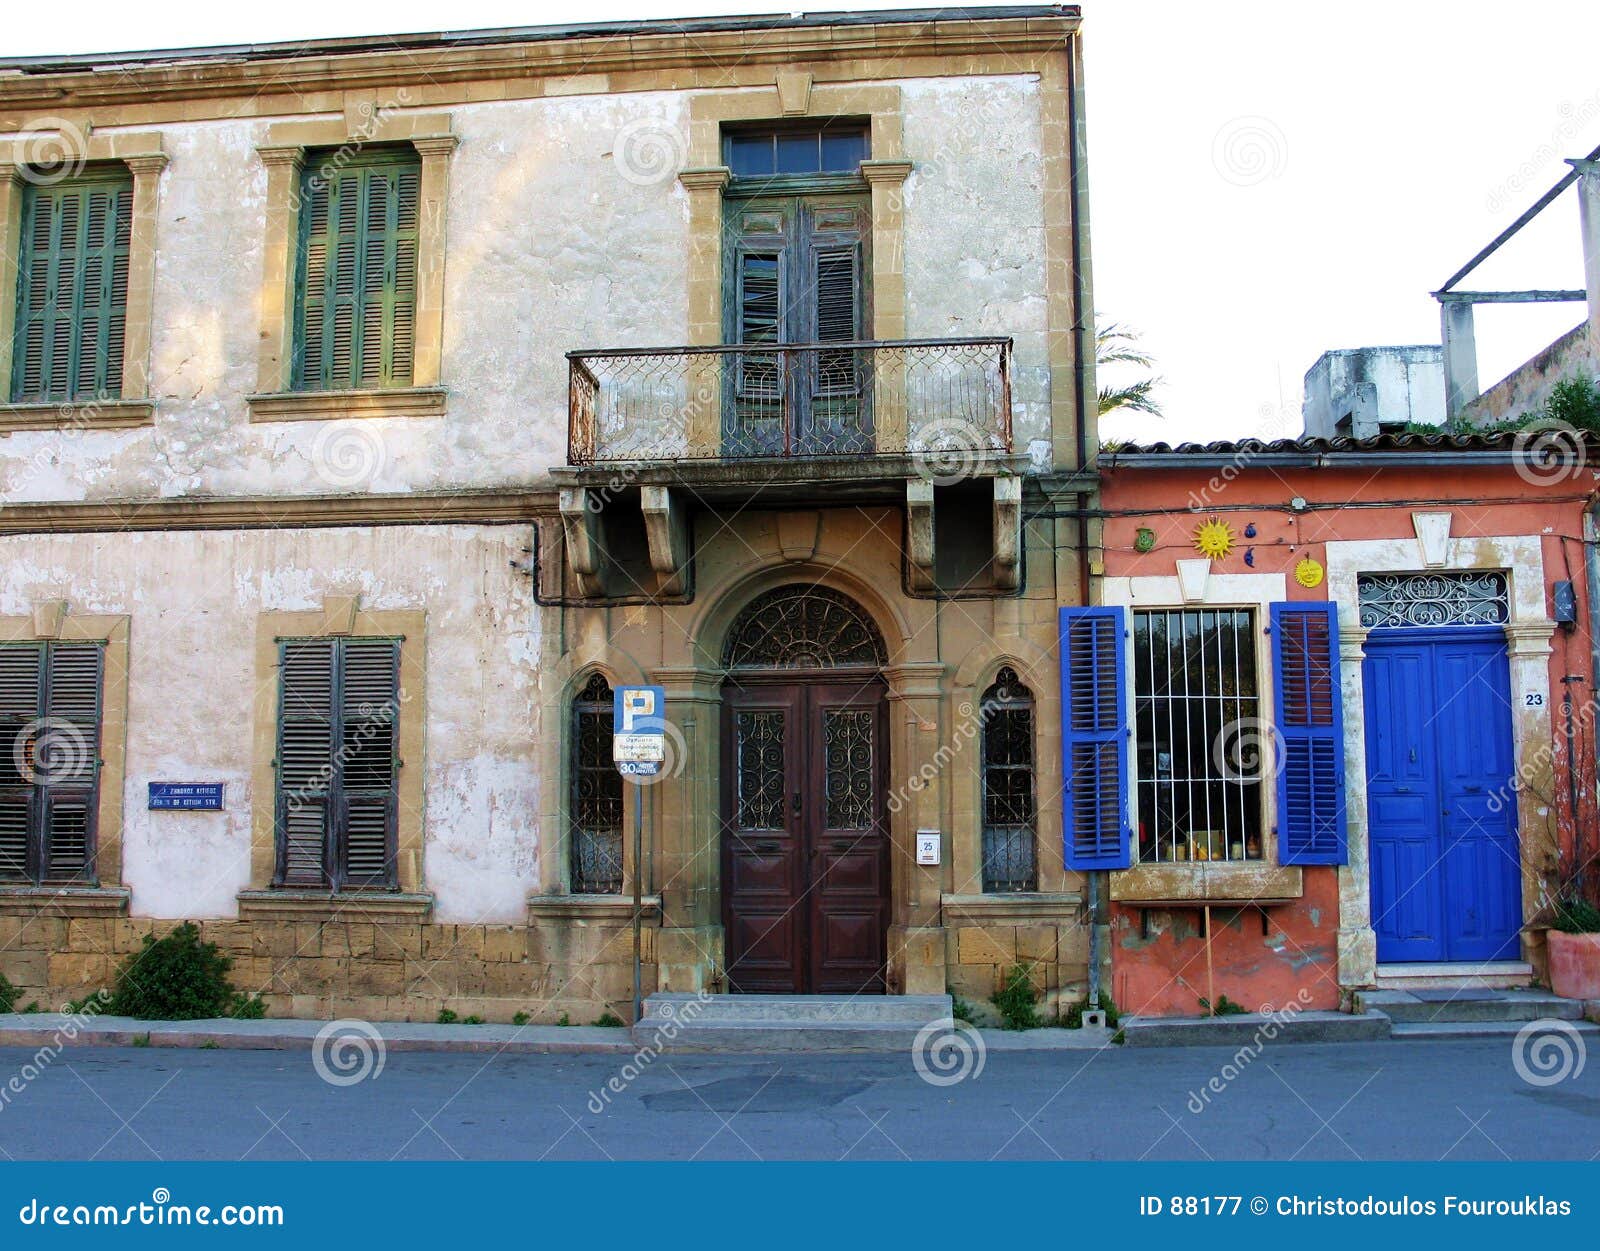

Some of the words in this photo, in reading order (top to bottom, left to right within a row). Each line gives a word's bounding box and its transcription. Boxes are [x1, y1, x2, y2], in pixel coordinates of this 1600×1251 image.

[1526, 694, 1543, 705] 23
[623, 690, 655, 730] P
[620, 764, 636, 774] 30
[924, 842, 933, 851] 25
